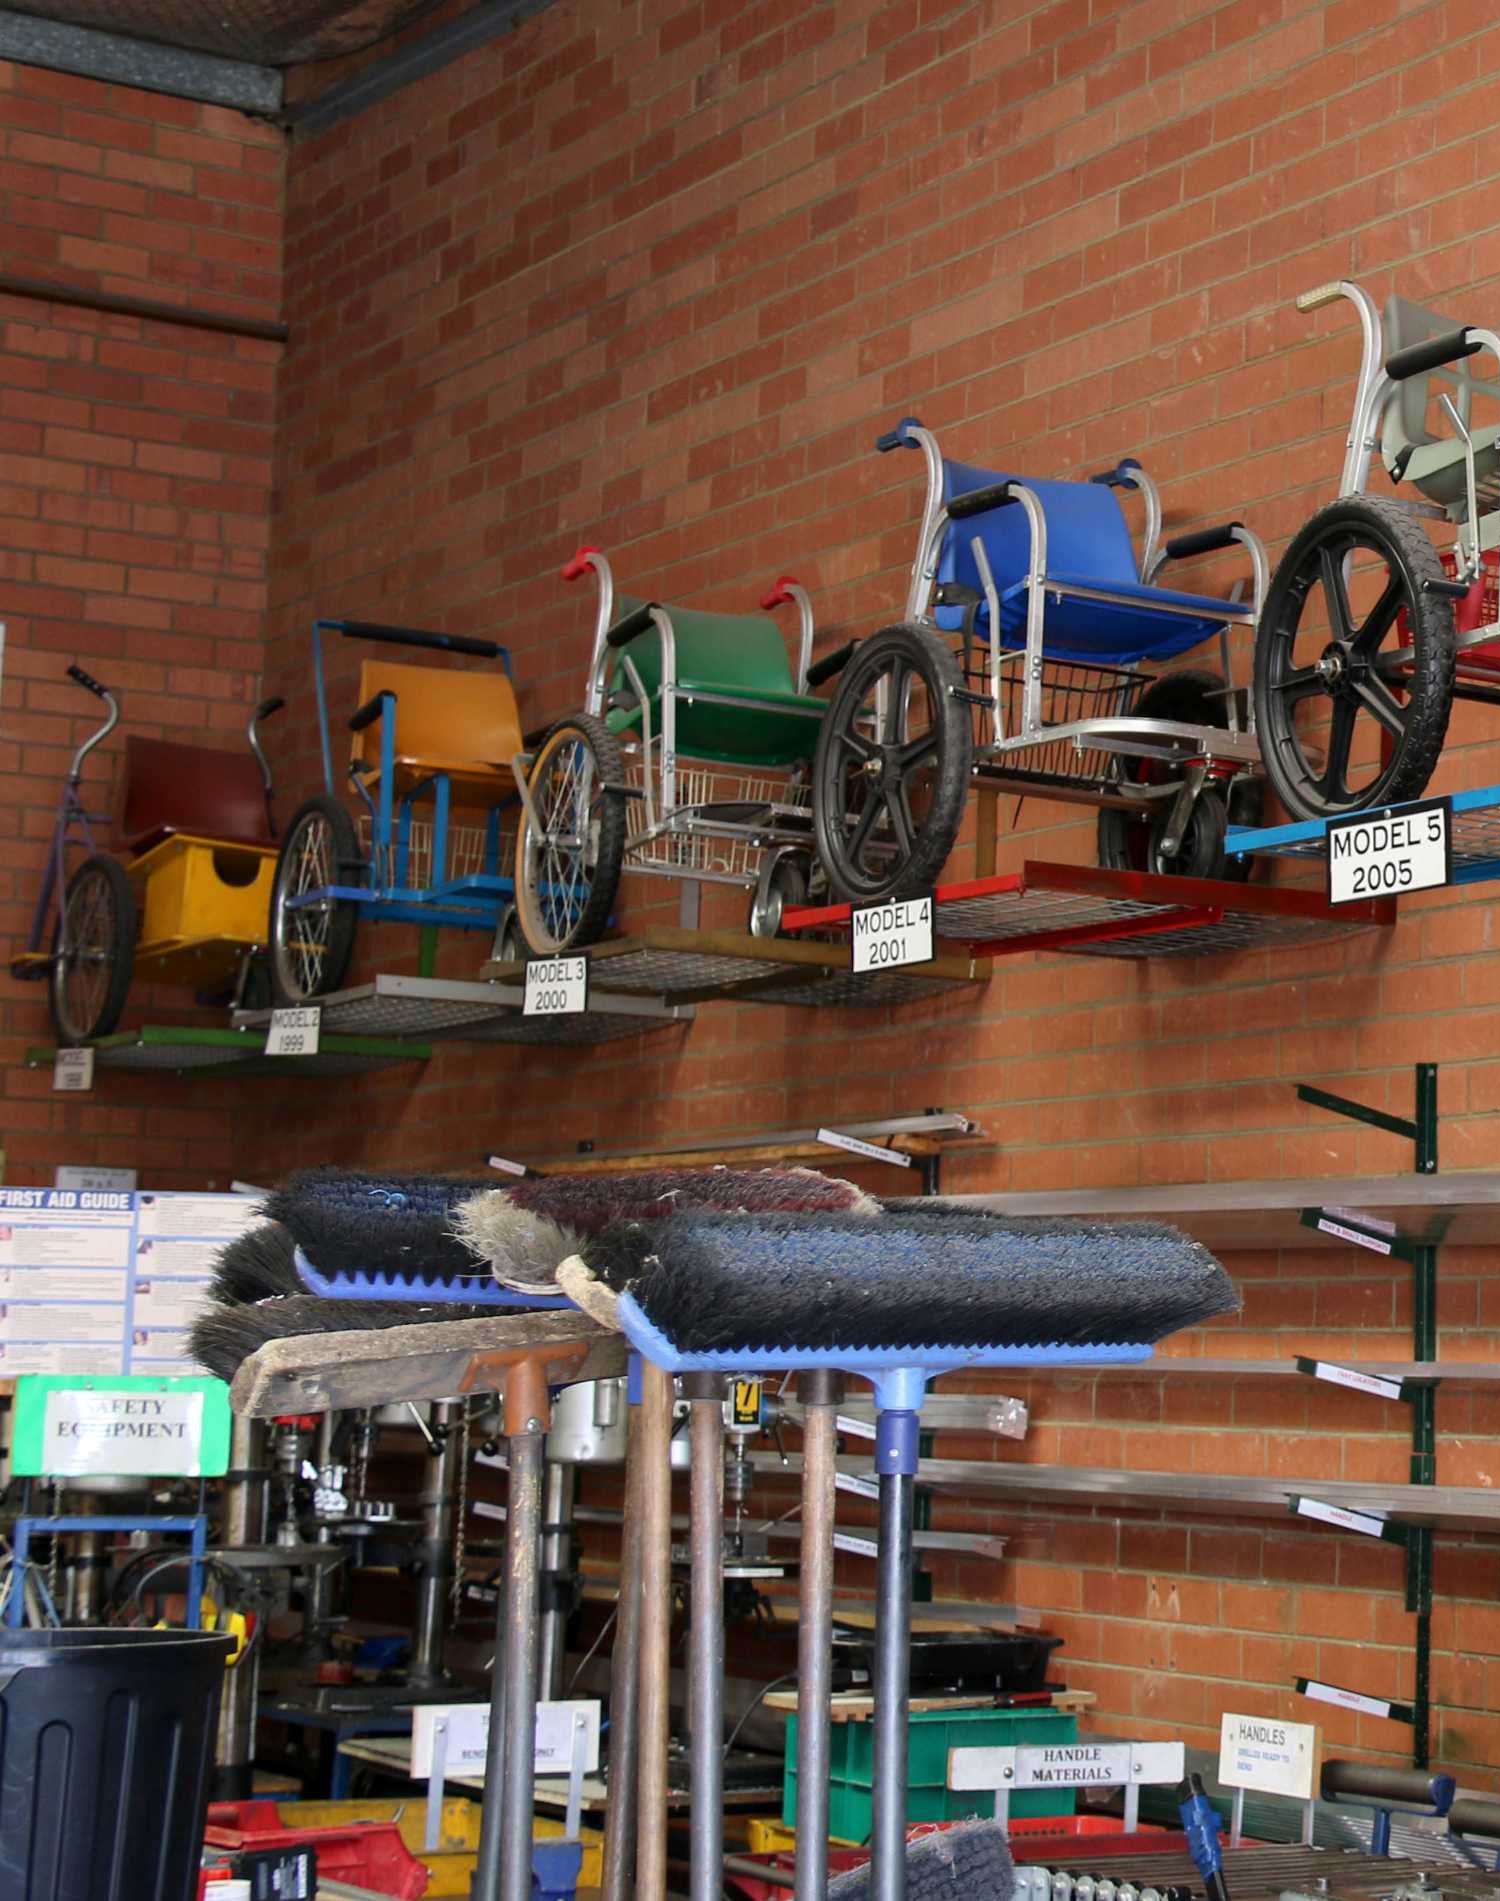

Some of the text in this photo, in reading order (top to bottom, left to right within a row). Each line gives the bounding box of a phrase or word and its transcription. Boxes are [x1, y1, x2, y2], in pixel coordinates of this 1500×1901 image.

[1334, 815, 1441, 859] MODEL 5
[1353, 859, 1412, 893] 2005
[856, 901, 928, 936] MODEL 4
[870, 938, 906, 964] 2001
[529, 961, 584, 984] MODEL 3
[536, 990, 567, 1010] 2000
[274, 1011, 309, 1028] MODEL
[0, 1191, 129, 1209] FIRST AID GUIDE
[89, 1400, 166, 1415] AFETY
[1240, 1723, 1285, 1746] HANDLES
[1044, 1749, 1101, 1762] HANDLE
[1032, 1768, 1112, 1781] MATERIALS
